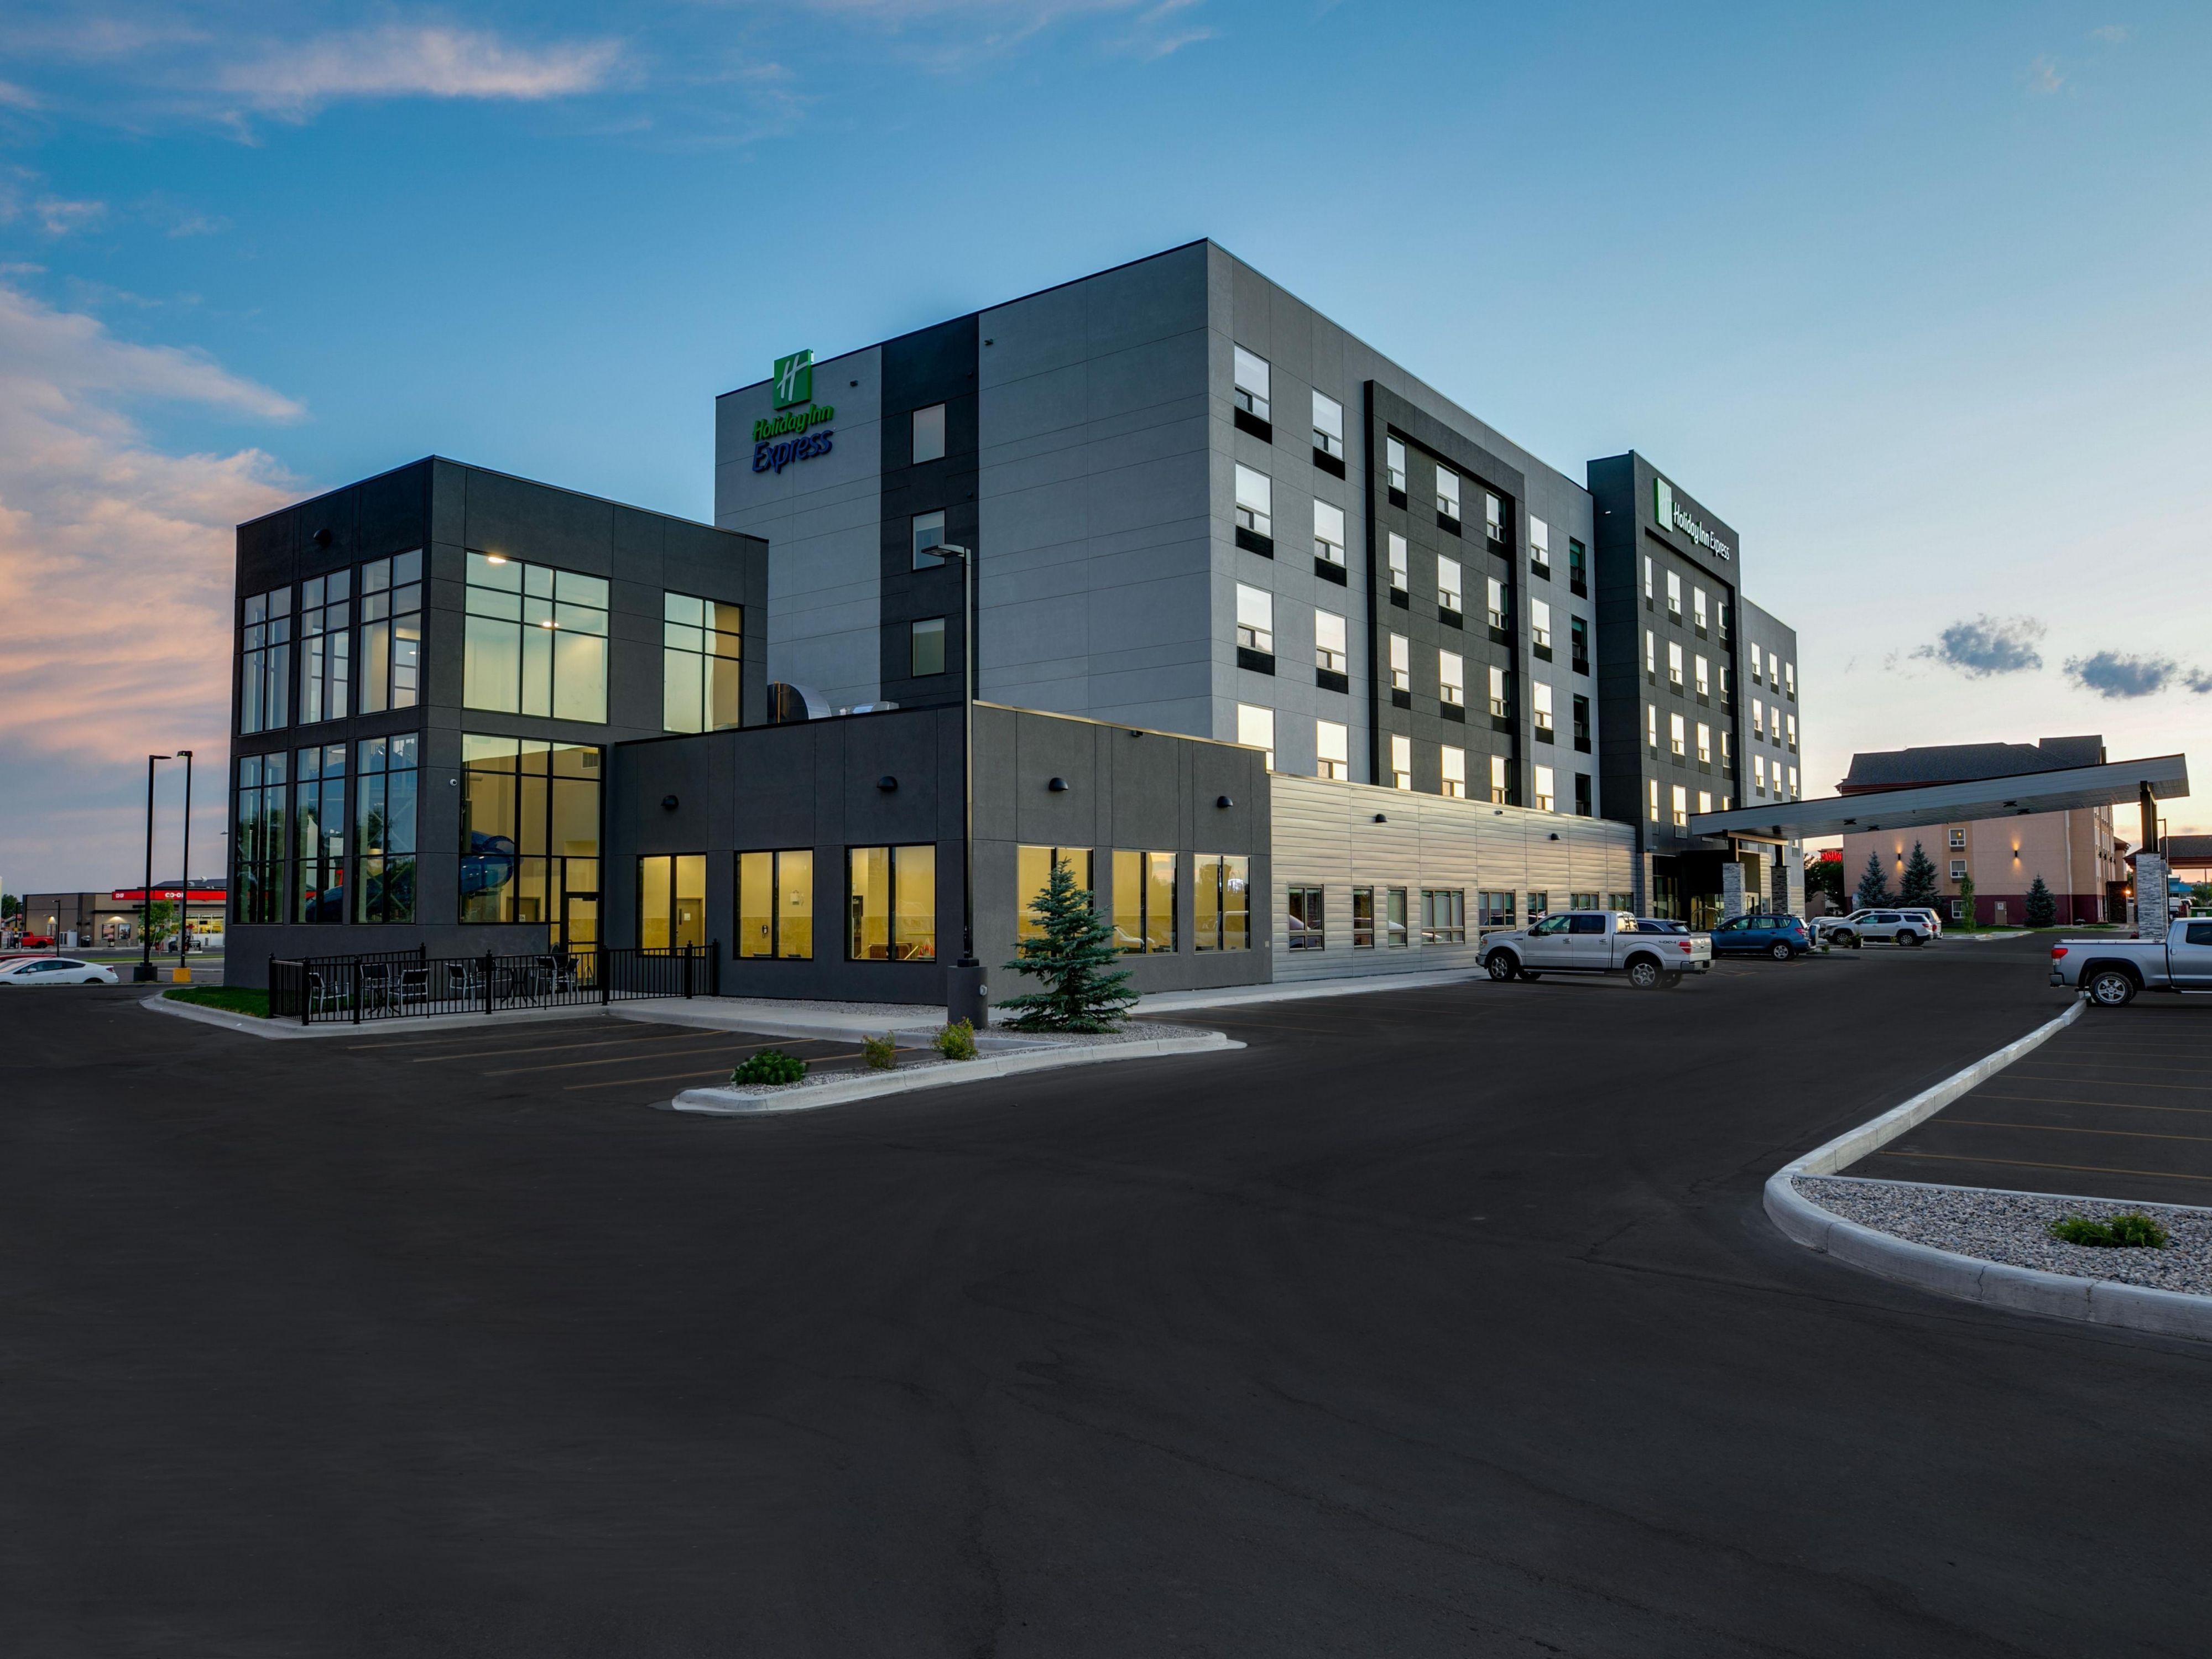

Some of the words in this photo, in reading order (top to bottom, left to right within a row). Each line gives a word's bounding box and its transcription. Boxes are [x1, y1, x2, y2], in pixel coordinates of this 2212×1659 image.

[753, 411, 808, 441] Holiday
[808, 404, 833, 425] Inn
[752, 430, 834, 474] Express
[1673, 502, 1699, 544] Holiday
[1699, 521, 1709, 547] Inn
[1710, 531, 1730, 560] Express
